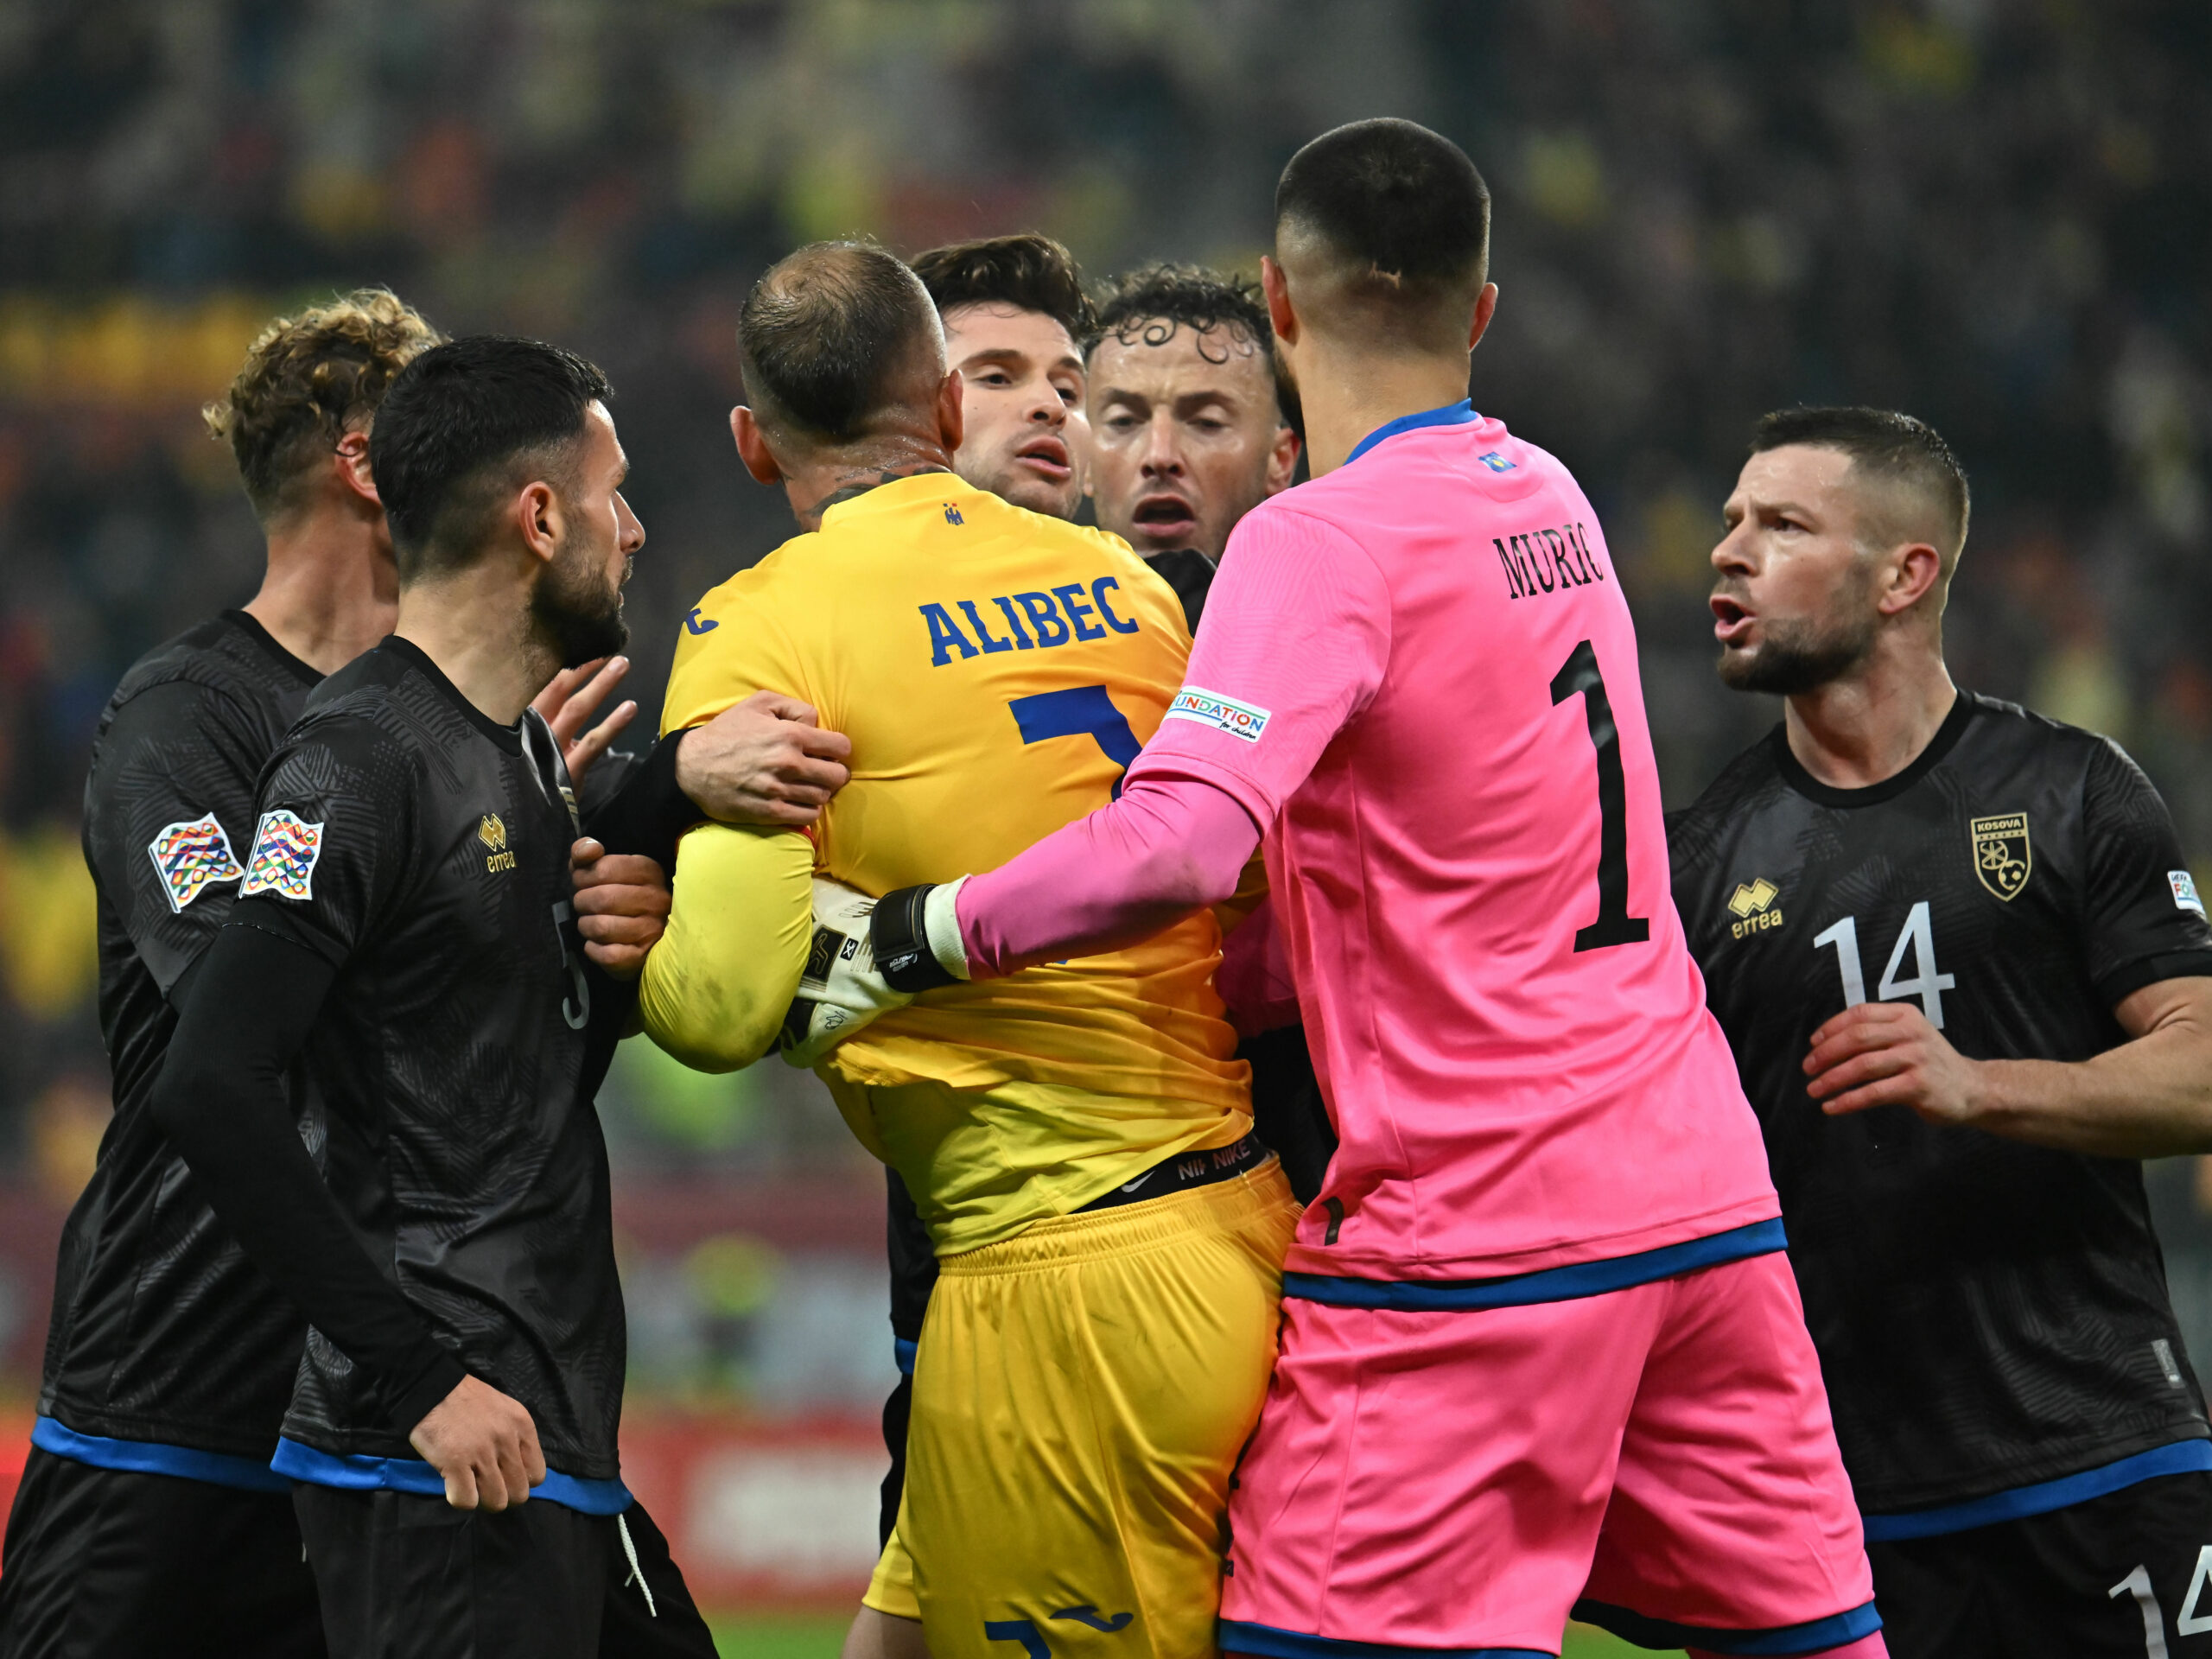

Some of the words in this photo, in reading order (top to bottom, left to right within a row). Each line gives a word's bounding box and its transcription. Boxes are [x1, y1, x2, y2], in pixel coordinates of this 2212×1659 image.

[1493, 522, 1604, 600] MURIC
[918, 576, 1140, 667] ALIBEC
[1173, 696, 1264, 732] UNDATION
[1231, 727, 1256, 740] children
[1549, 639, 1649, 952] 1
[1977, 818, 2021, 832] KOSOVA
[1814, 901, 1955, 1029] 14
[1212, 1139, 1251, 1170] NIKE
